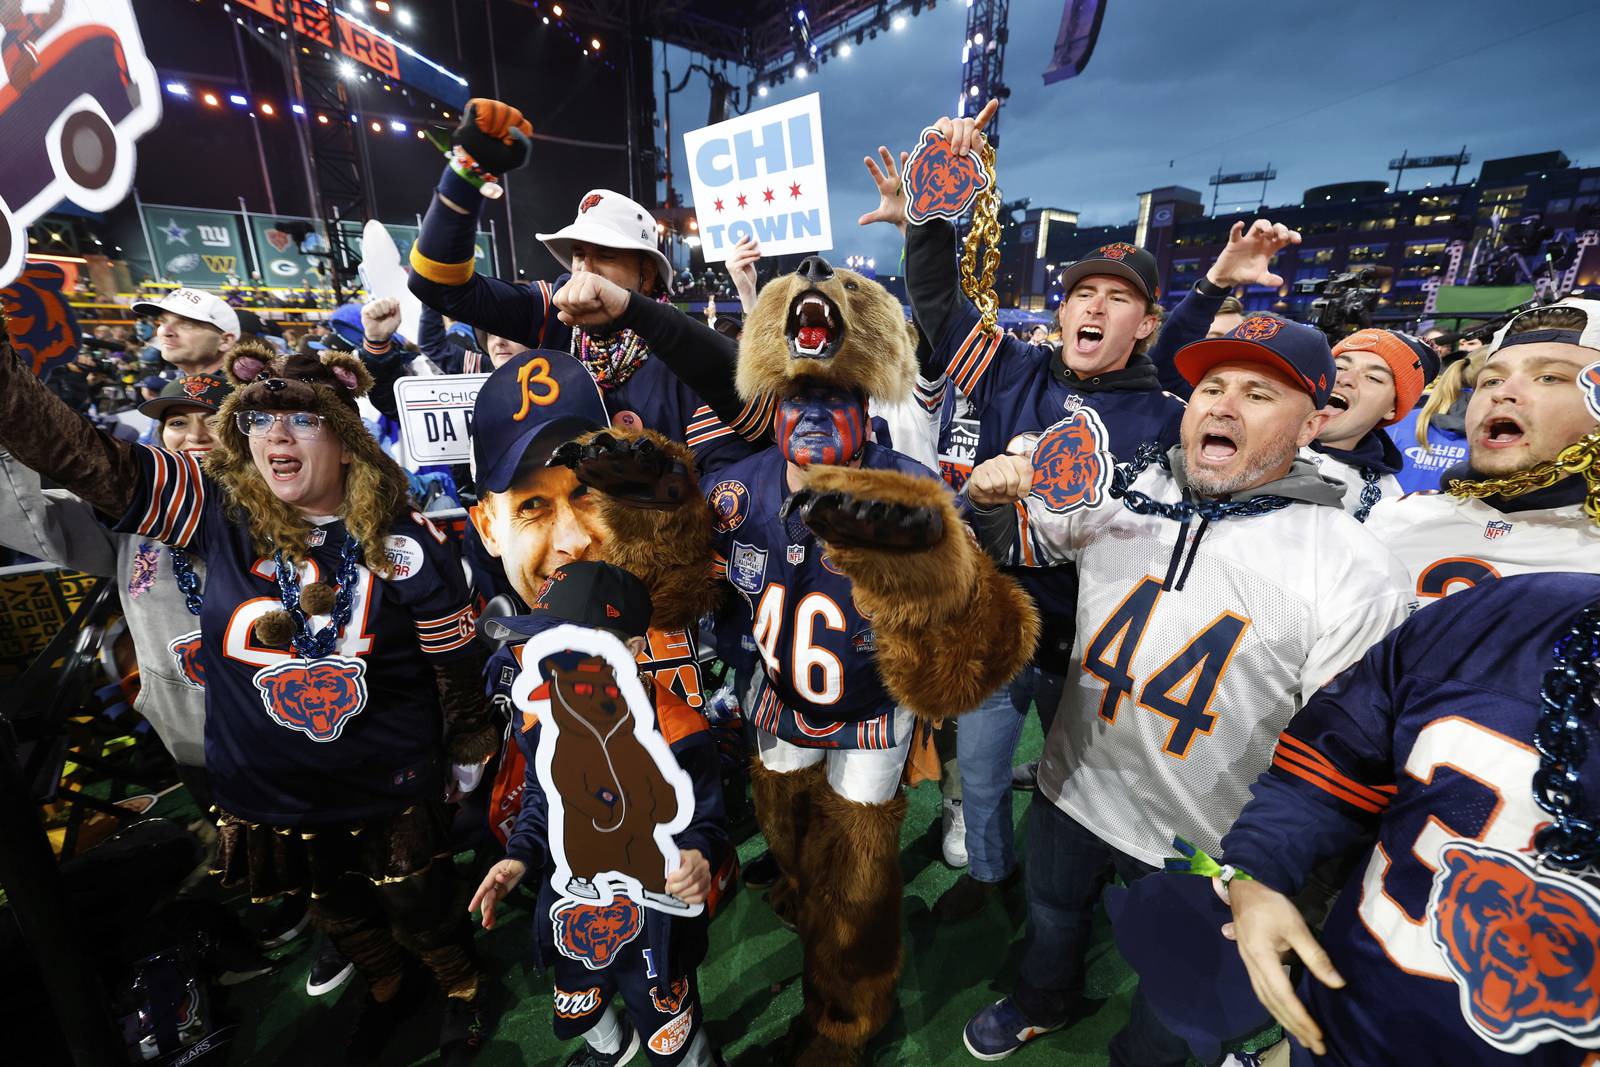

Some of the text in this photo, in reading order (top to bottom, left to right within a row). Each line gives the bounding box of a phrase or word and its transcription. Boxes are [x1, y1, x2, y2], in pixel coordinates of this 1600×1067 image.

[696, 113, 814, 187] CHI
[707, 208, 821, 249] TOWN
[512, 356, 560, 422] B
[424, 411, 457, 442] DA
[950, 434, 979, 447] IDERS
[1415, 449, 1464, 468] UNIVE
[753, 582, 846, 705] 46
[1083, 575, 1251, 760] 44
